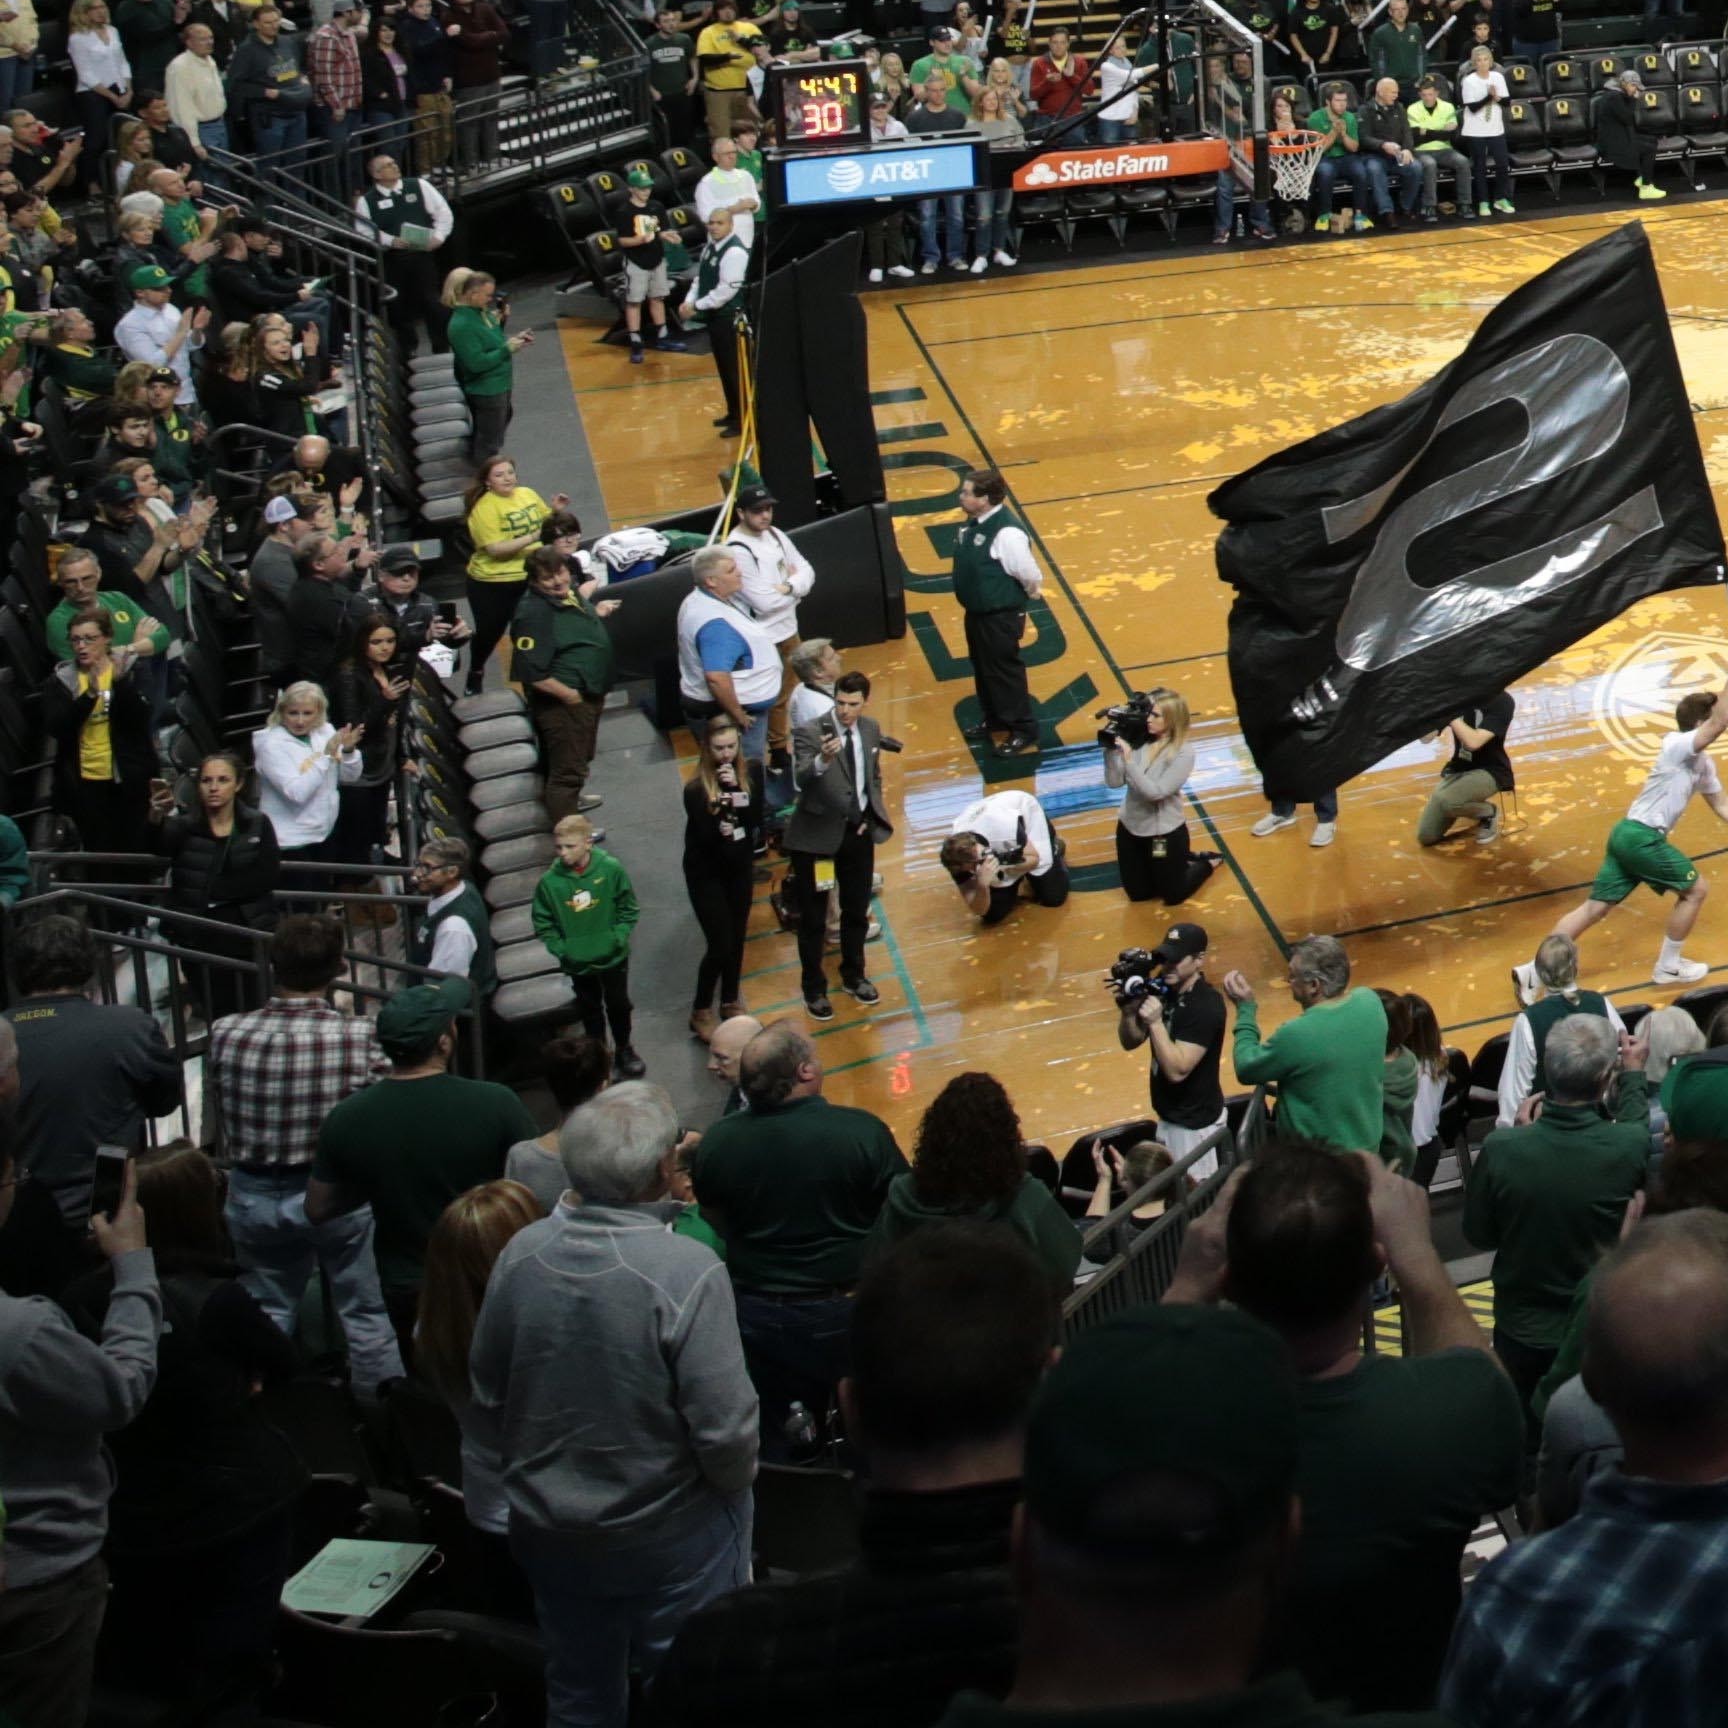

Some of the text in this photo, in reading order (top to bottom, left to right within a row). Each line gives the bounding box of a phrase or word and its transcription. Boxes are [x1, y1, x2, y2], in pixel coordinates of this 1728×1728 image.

[800, 73, 858, 95] 4:47
[803, 103, 843, 135] 30
[869, 159, 934, 183] AT&T
